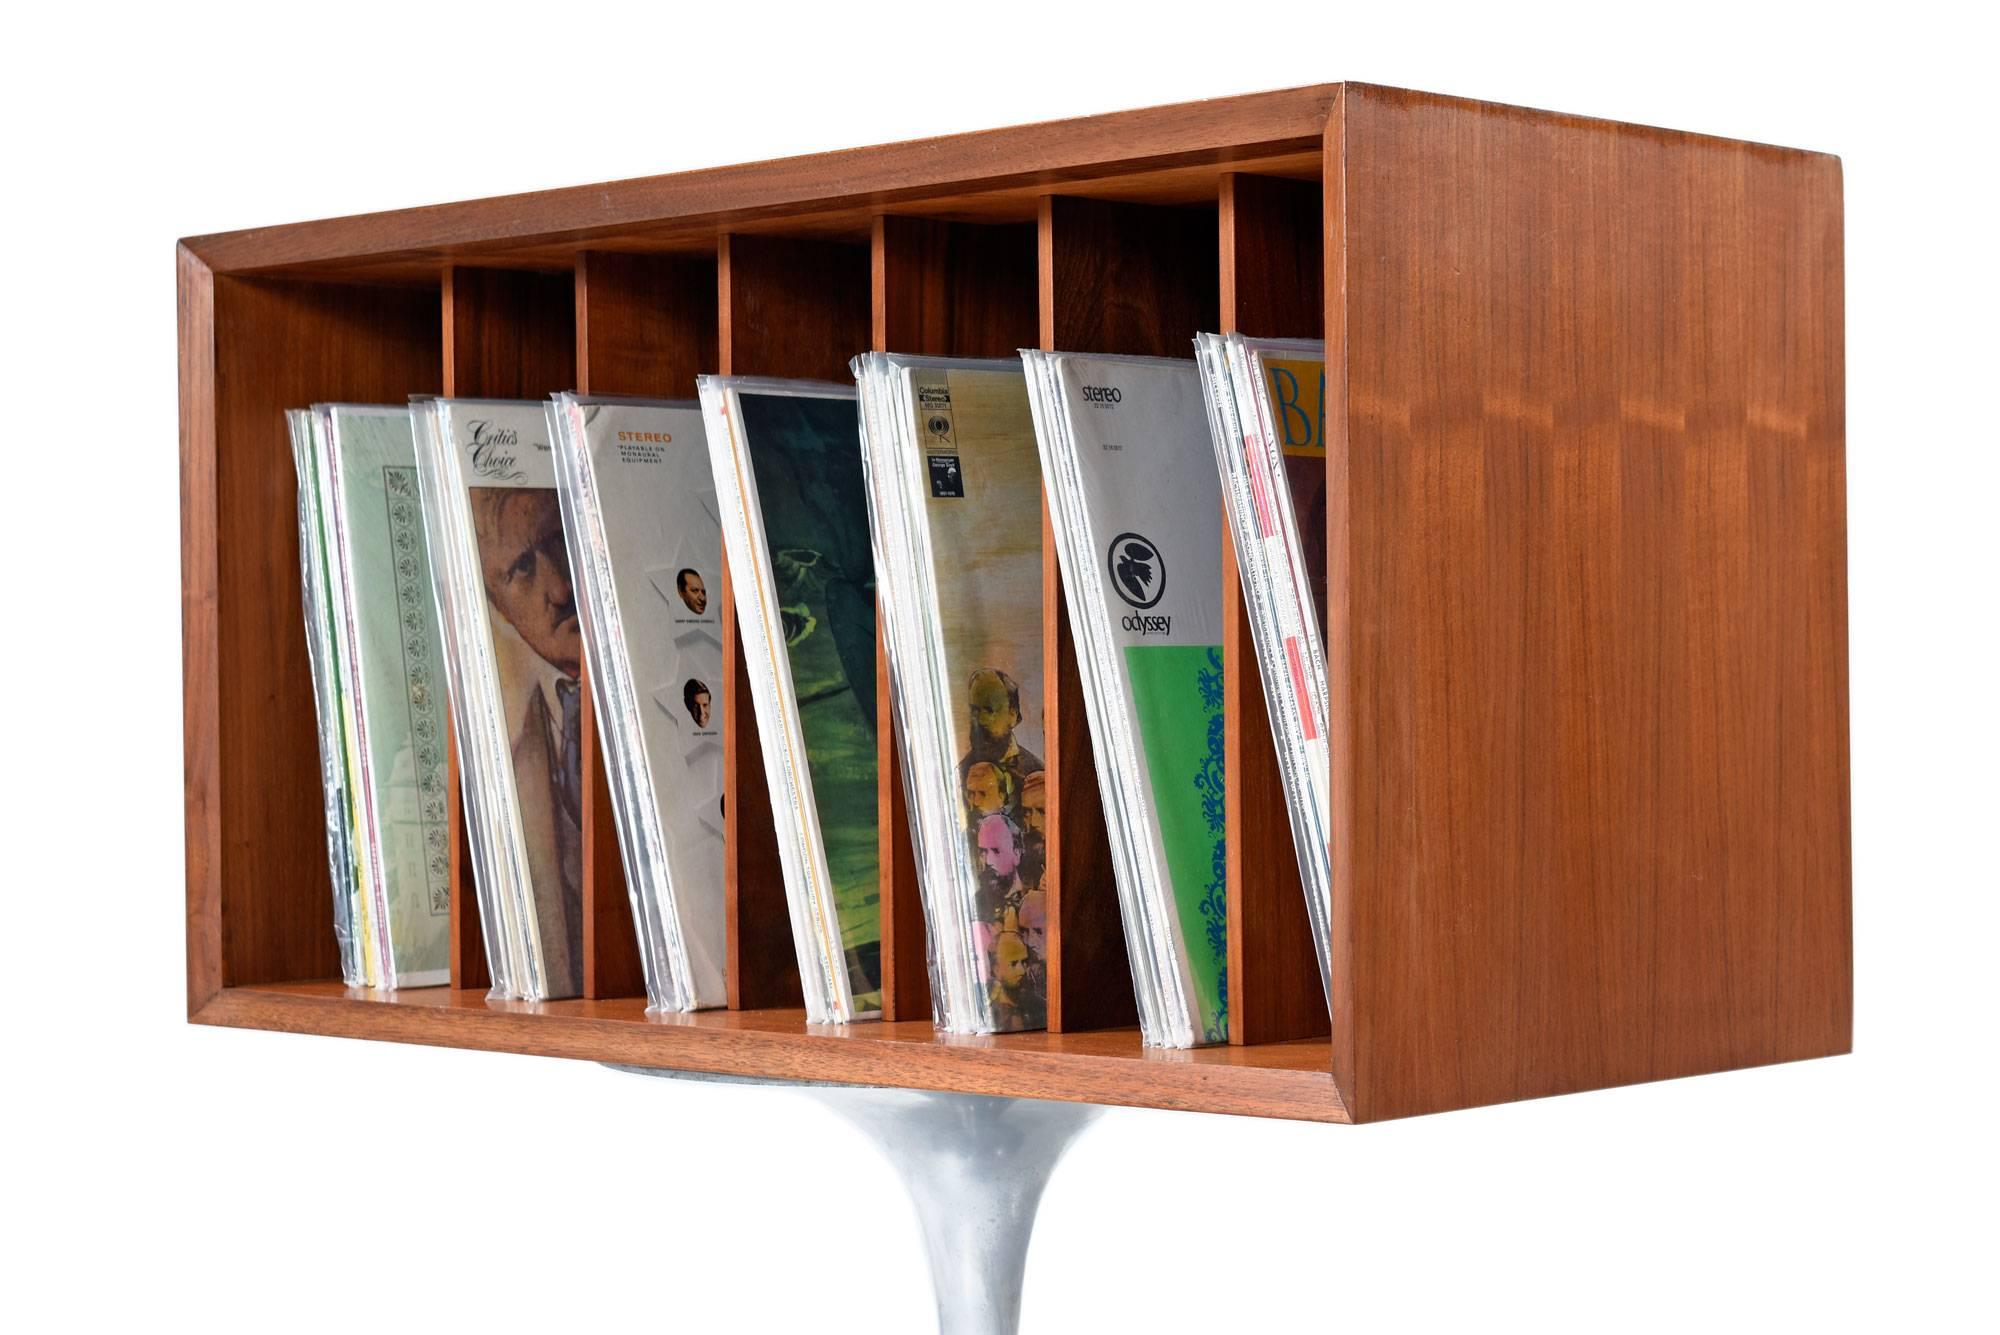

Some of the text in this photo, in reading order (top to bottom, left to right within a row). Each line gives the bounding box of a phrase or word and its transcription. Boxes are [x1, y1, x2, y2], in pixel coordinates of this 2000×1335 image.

[1082, 384, 1122, 403] stereo
[617, 431, 672, 443] STEREO
[1121, 609, 1171, 636] odyssey
[1312, 648, 1323, 670] BACH
